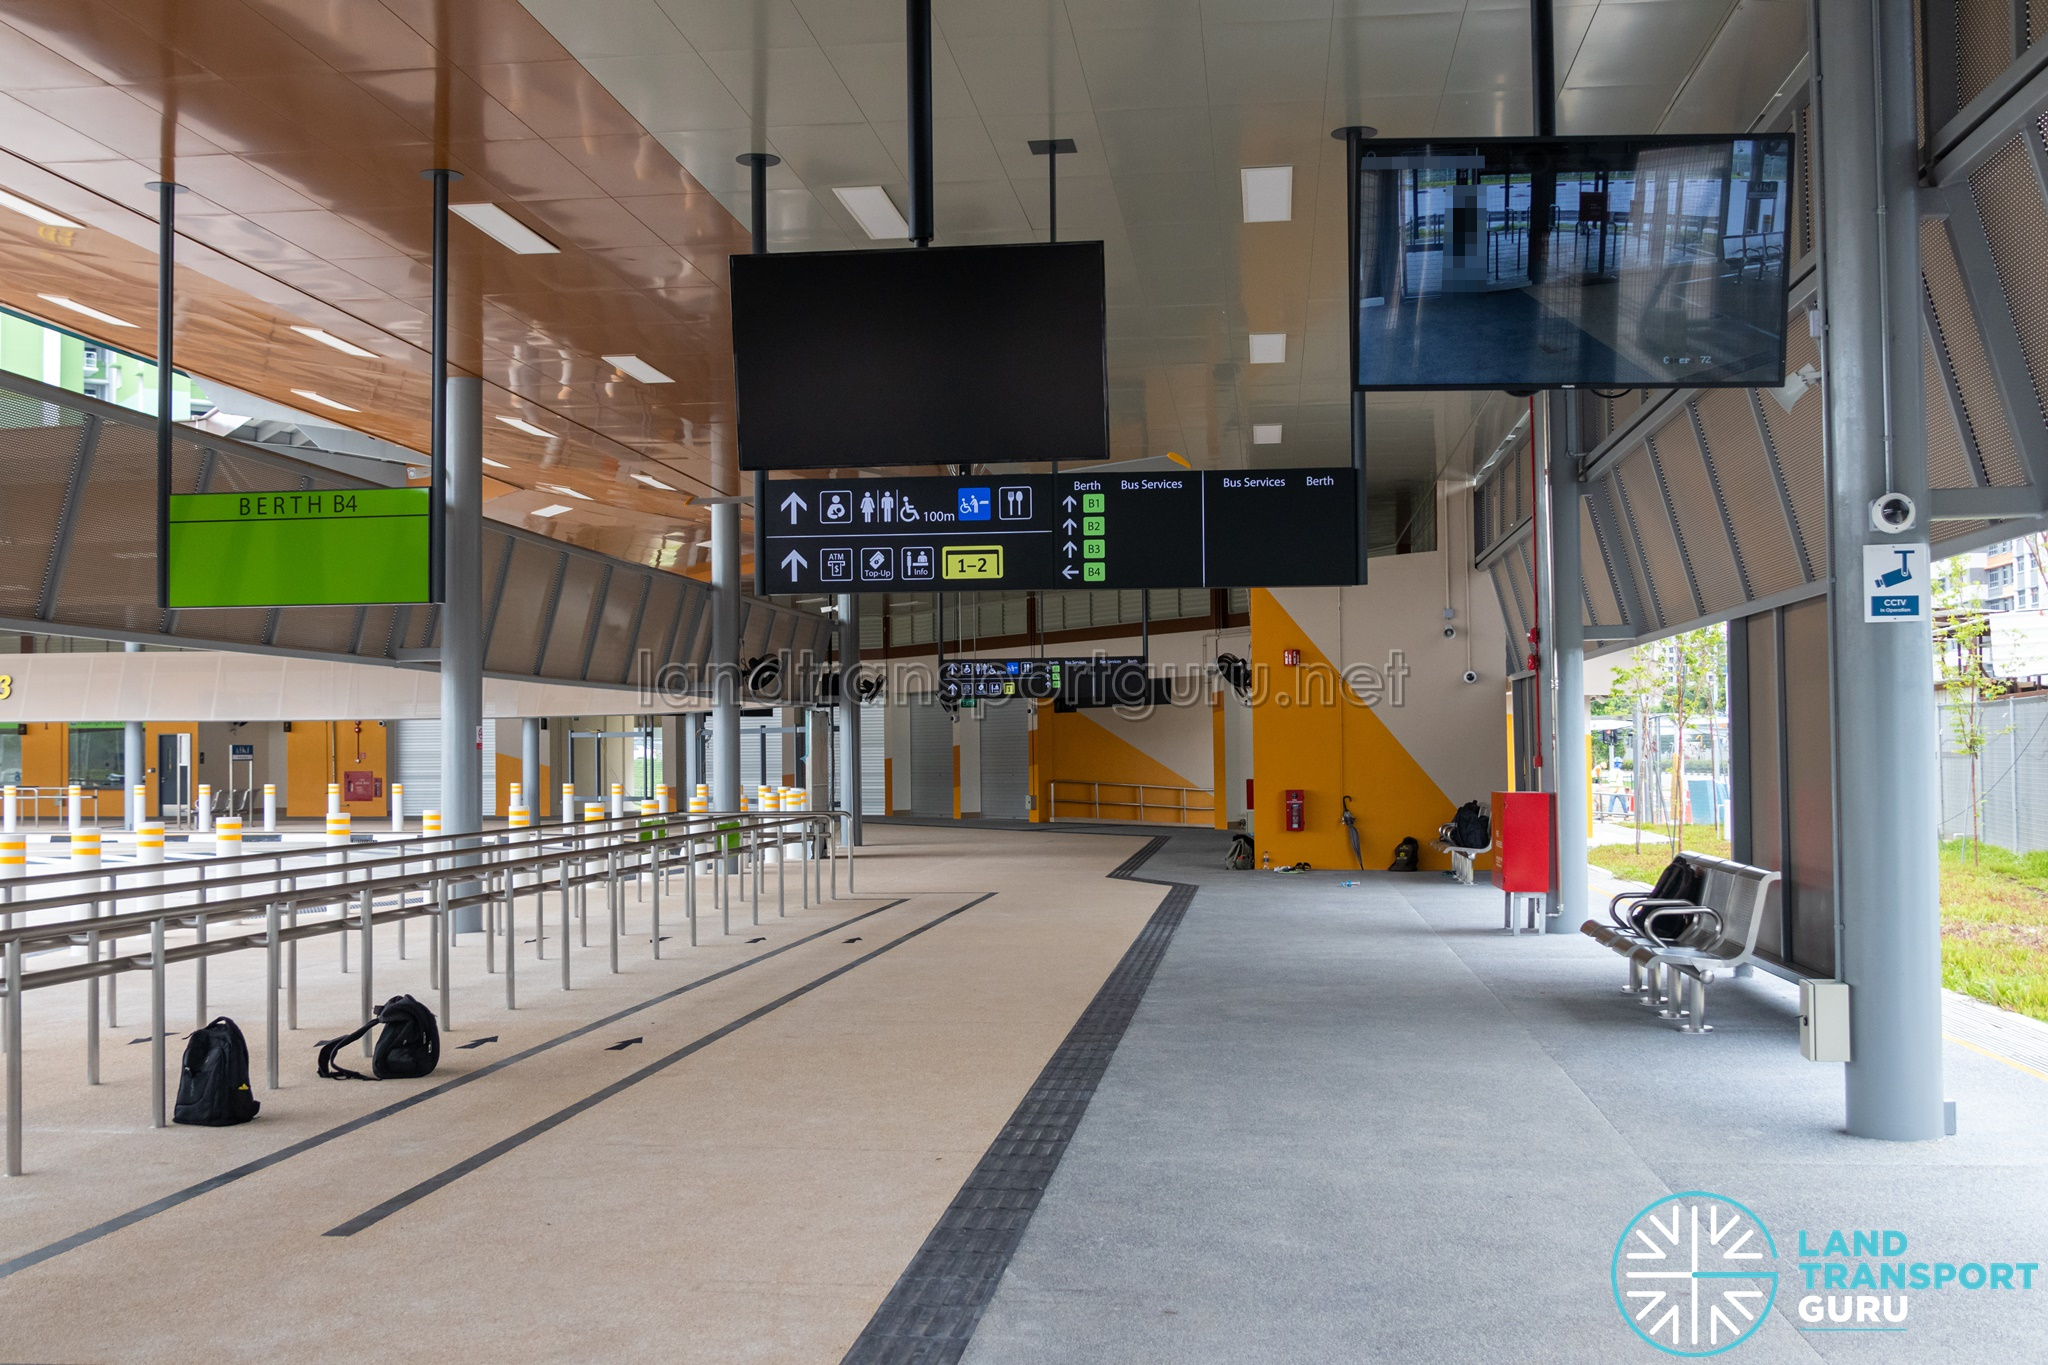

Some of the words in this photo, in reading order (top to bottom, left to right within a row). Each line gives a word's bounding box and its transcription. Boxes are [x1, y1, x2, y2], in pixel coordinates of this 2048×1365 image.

[1699, 355, 1712, 364] 72
[1073, 480, 1101, 491] Berth
[1120, 480, 1140, 490] Bus
[1141, 479, 1183, 490] Services
[1223, 477, 1242, 488] Bus
[1243, 477, 1286, 488] Services
[1306, 476, 1334, 487] Berth
[239, 495, 322, 516] BERTH
[333, 494, 358, 513] B4
[1088, 498, 1100, 508] B1
[923, 511, 955, 523] 100m
[1087, 521, 1101, 531] B2
[1088, 544, 1101, 554] B3
[828, 552, 844, 561] ATM
[864, 568, 891, 579] Top-Up
[914, 567, 929, 576] Info
[1087, 567, 1101, 577] B4
